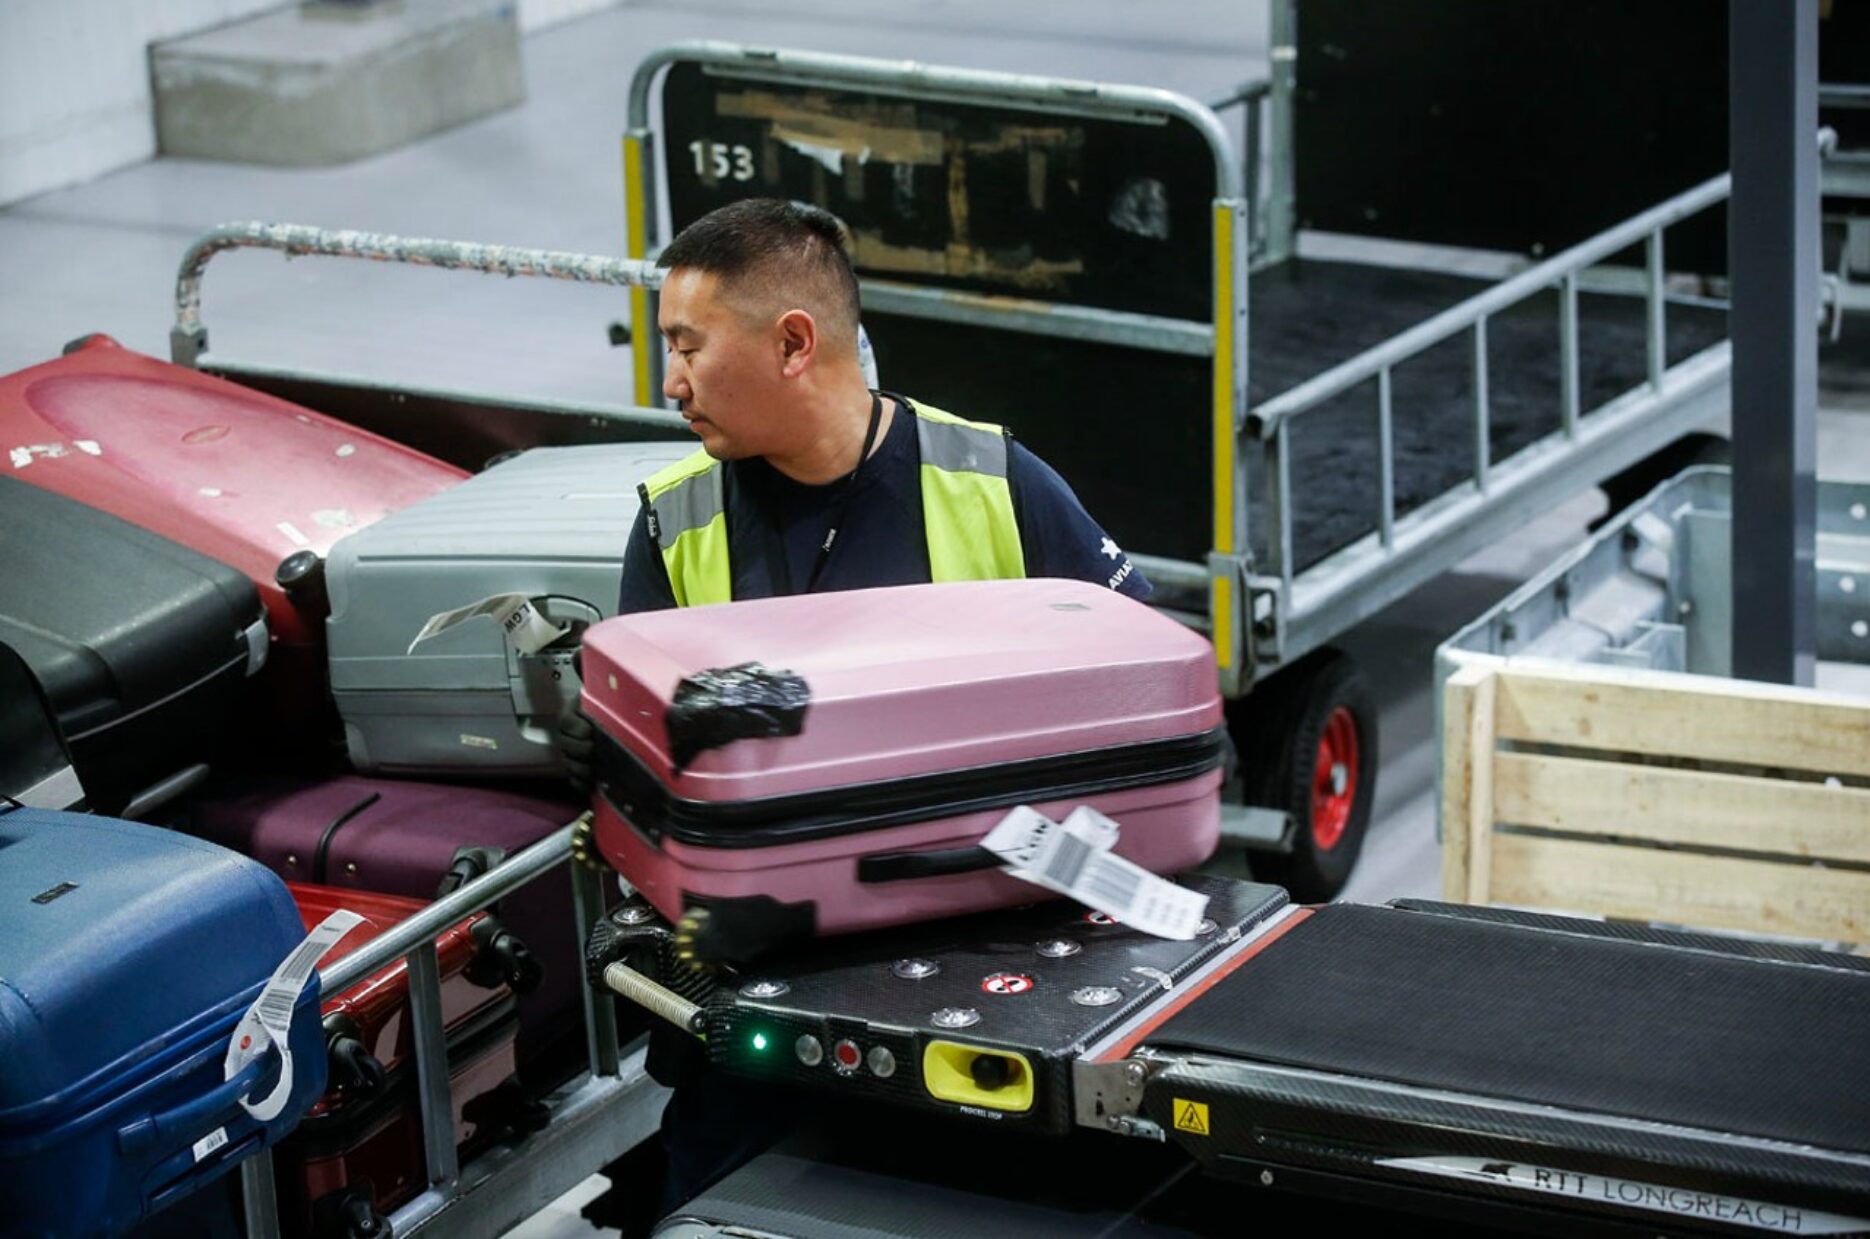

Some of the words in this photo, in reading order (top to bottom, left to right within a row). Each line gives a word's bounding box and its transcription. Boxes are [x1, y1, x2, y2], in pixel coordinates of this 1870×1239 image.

[689, 140, 755, 181] 153
[504, 603, 530, 633] LGW
[1534, 1167, 1589, 1194] RTT
[1603, 1179, 1801, 1231] LONGREACH
